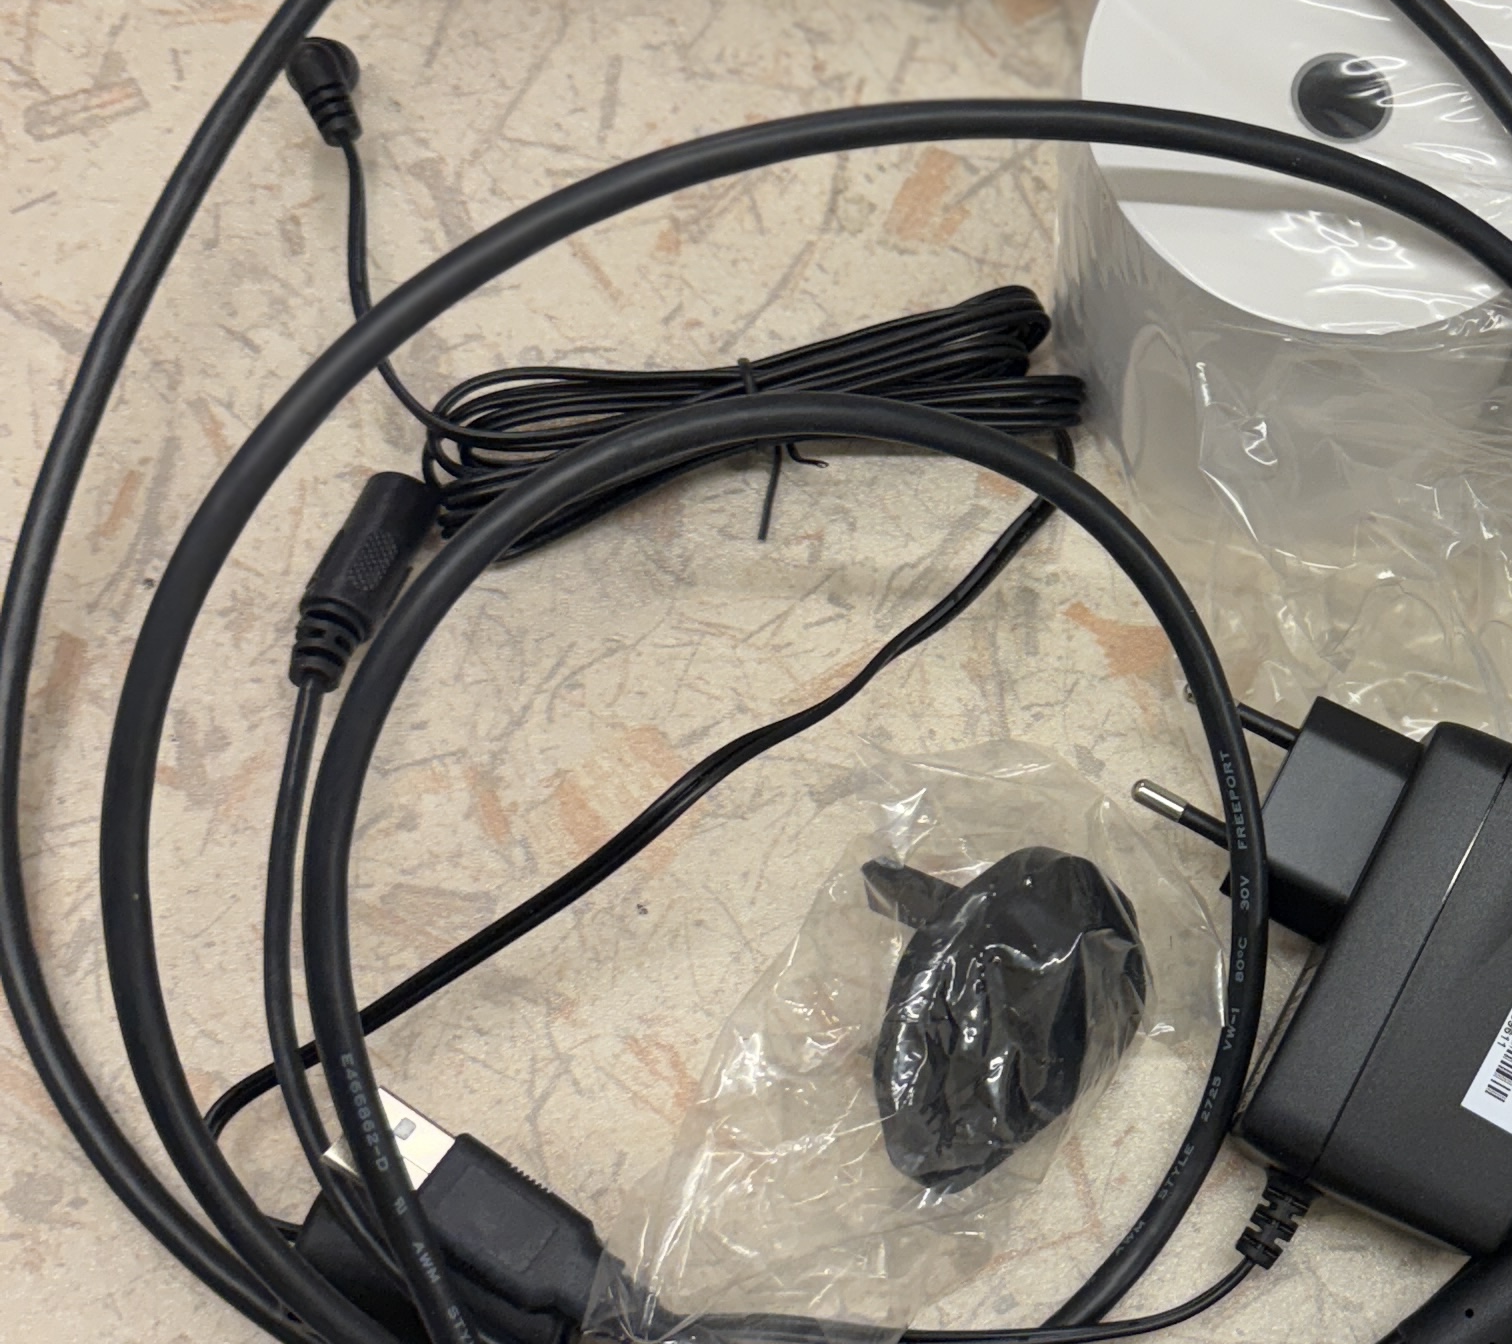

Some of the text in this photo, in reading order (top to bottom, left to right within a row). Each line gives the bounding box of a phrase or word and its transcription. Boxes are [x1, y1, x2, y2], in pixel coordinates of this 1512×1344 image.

[1219, 750, 1248, 850] FREEPORT
[1239, 875, 1251, 911] 30V
[1222, 1008, 1240, 1050] VW-1
[1202, 1076, 1222, 1122] 2725
[341, 1053, 389, 1172] E466862-D
[412, 1239, 440, 1284] AWM
[1158, 1143, 1195, 1200] STYLE
